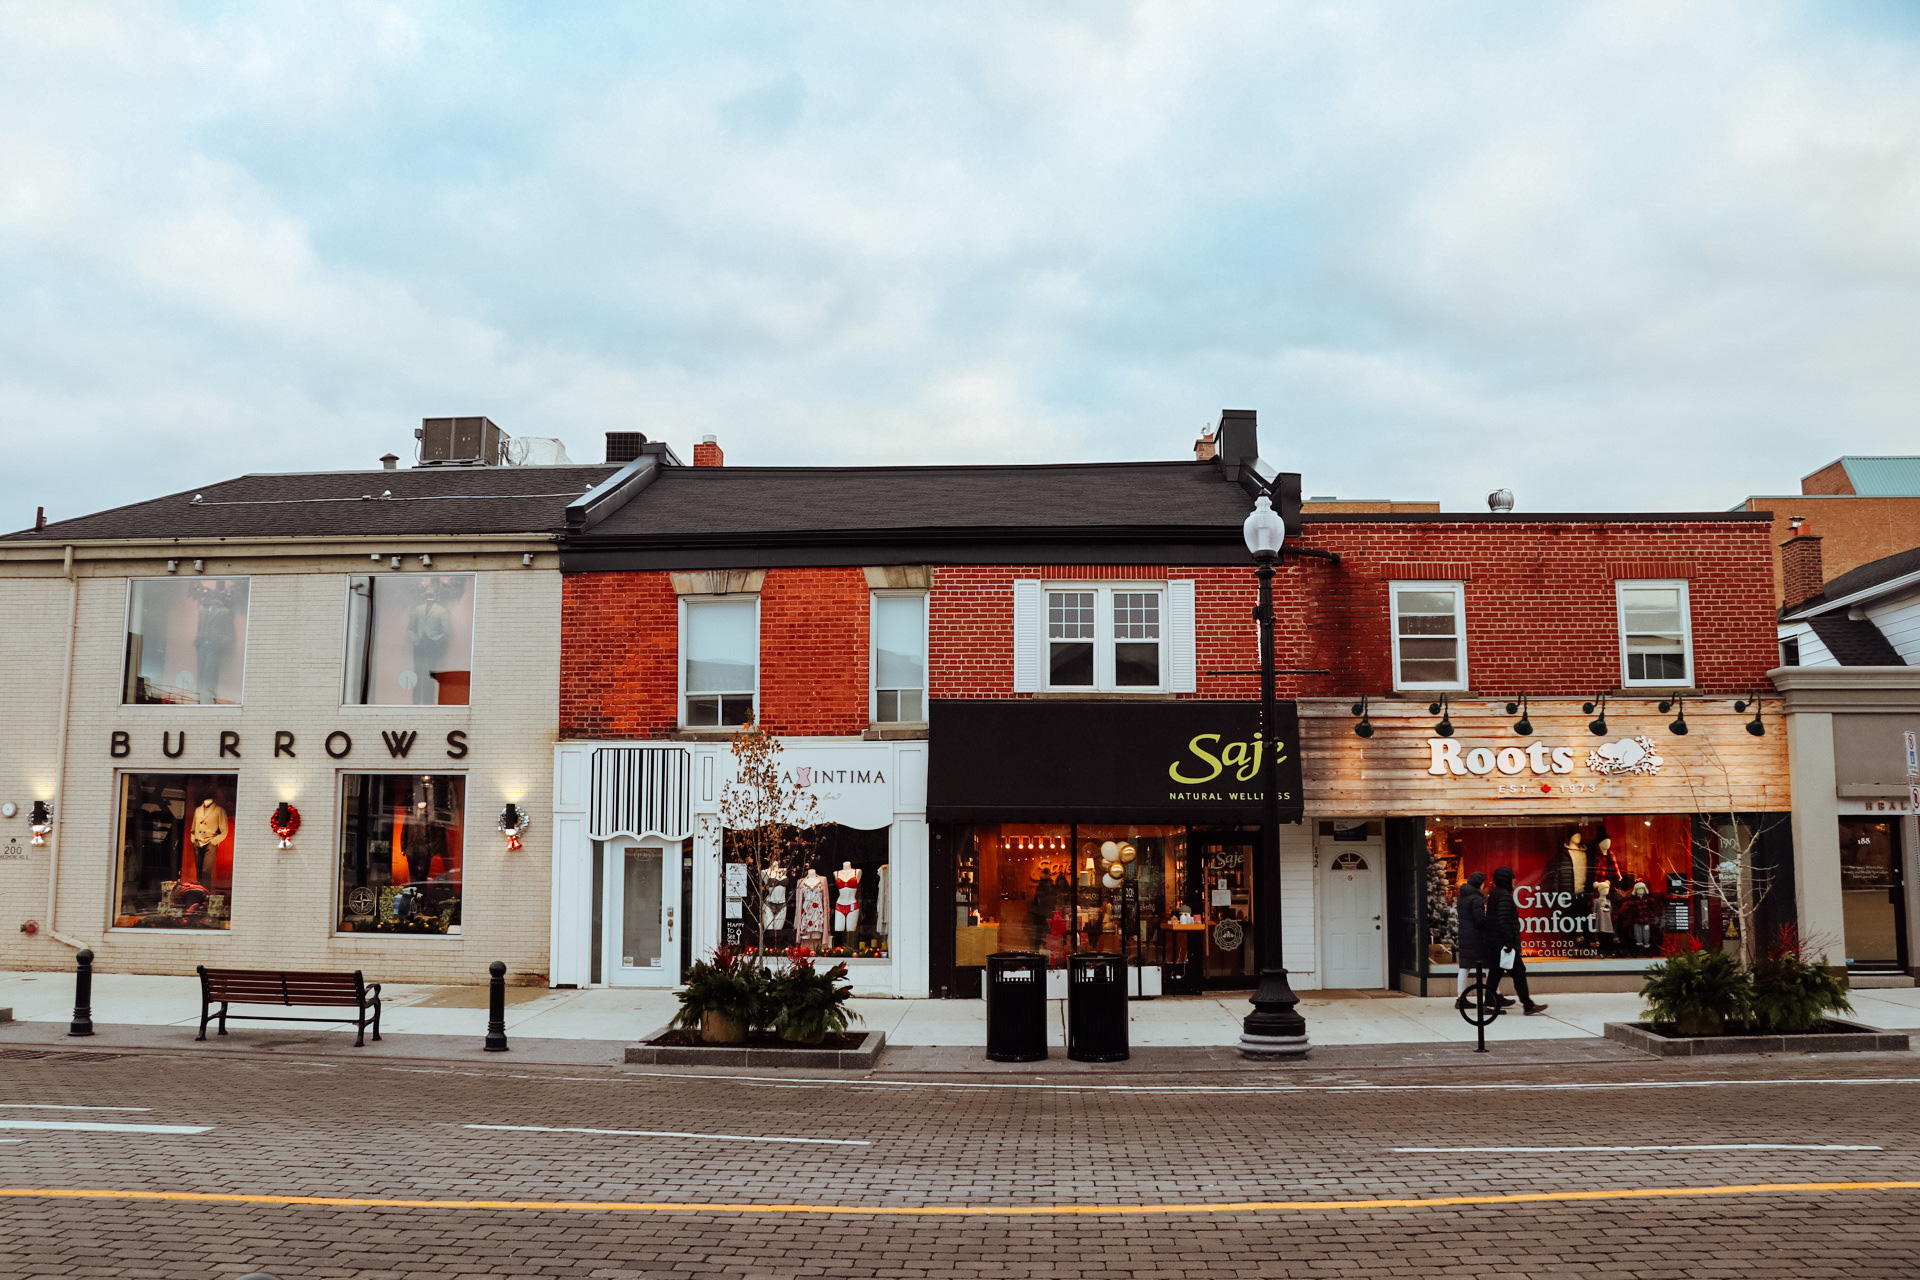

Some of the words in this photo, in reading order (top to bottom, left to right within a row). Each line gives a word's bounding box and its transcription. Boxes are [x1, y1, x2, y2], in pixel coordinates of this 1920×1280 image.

[110, 730, 469, 759] BURROWS
[1427, 738, 1574, 775] Roots
[814, 770, 886, 784] INTIMA
[1499, 784, 1535, 793] EST.
[1560, 784, 1596, 793] 1973
[1169, 792, 1222, 800] NATURAL
[1228, 792, 1290, 800] WELLSS
[1857, 837, 1871, 845] 188
[4, 846, 22, 855] 200
[1211, 852, 1245, 869] Saje
[1513, 885, 1572, 909] Give
[1518, 910, 1597, 933] mfort
[1520, 940, 1547, 948] OOTS
[1551, 940, 1574, 948] 2020
[1537, 949, 1598, 957] COLLECTION
